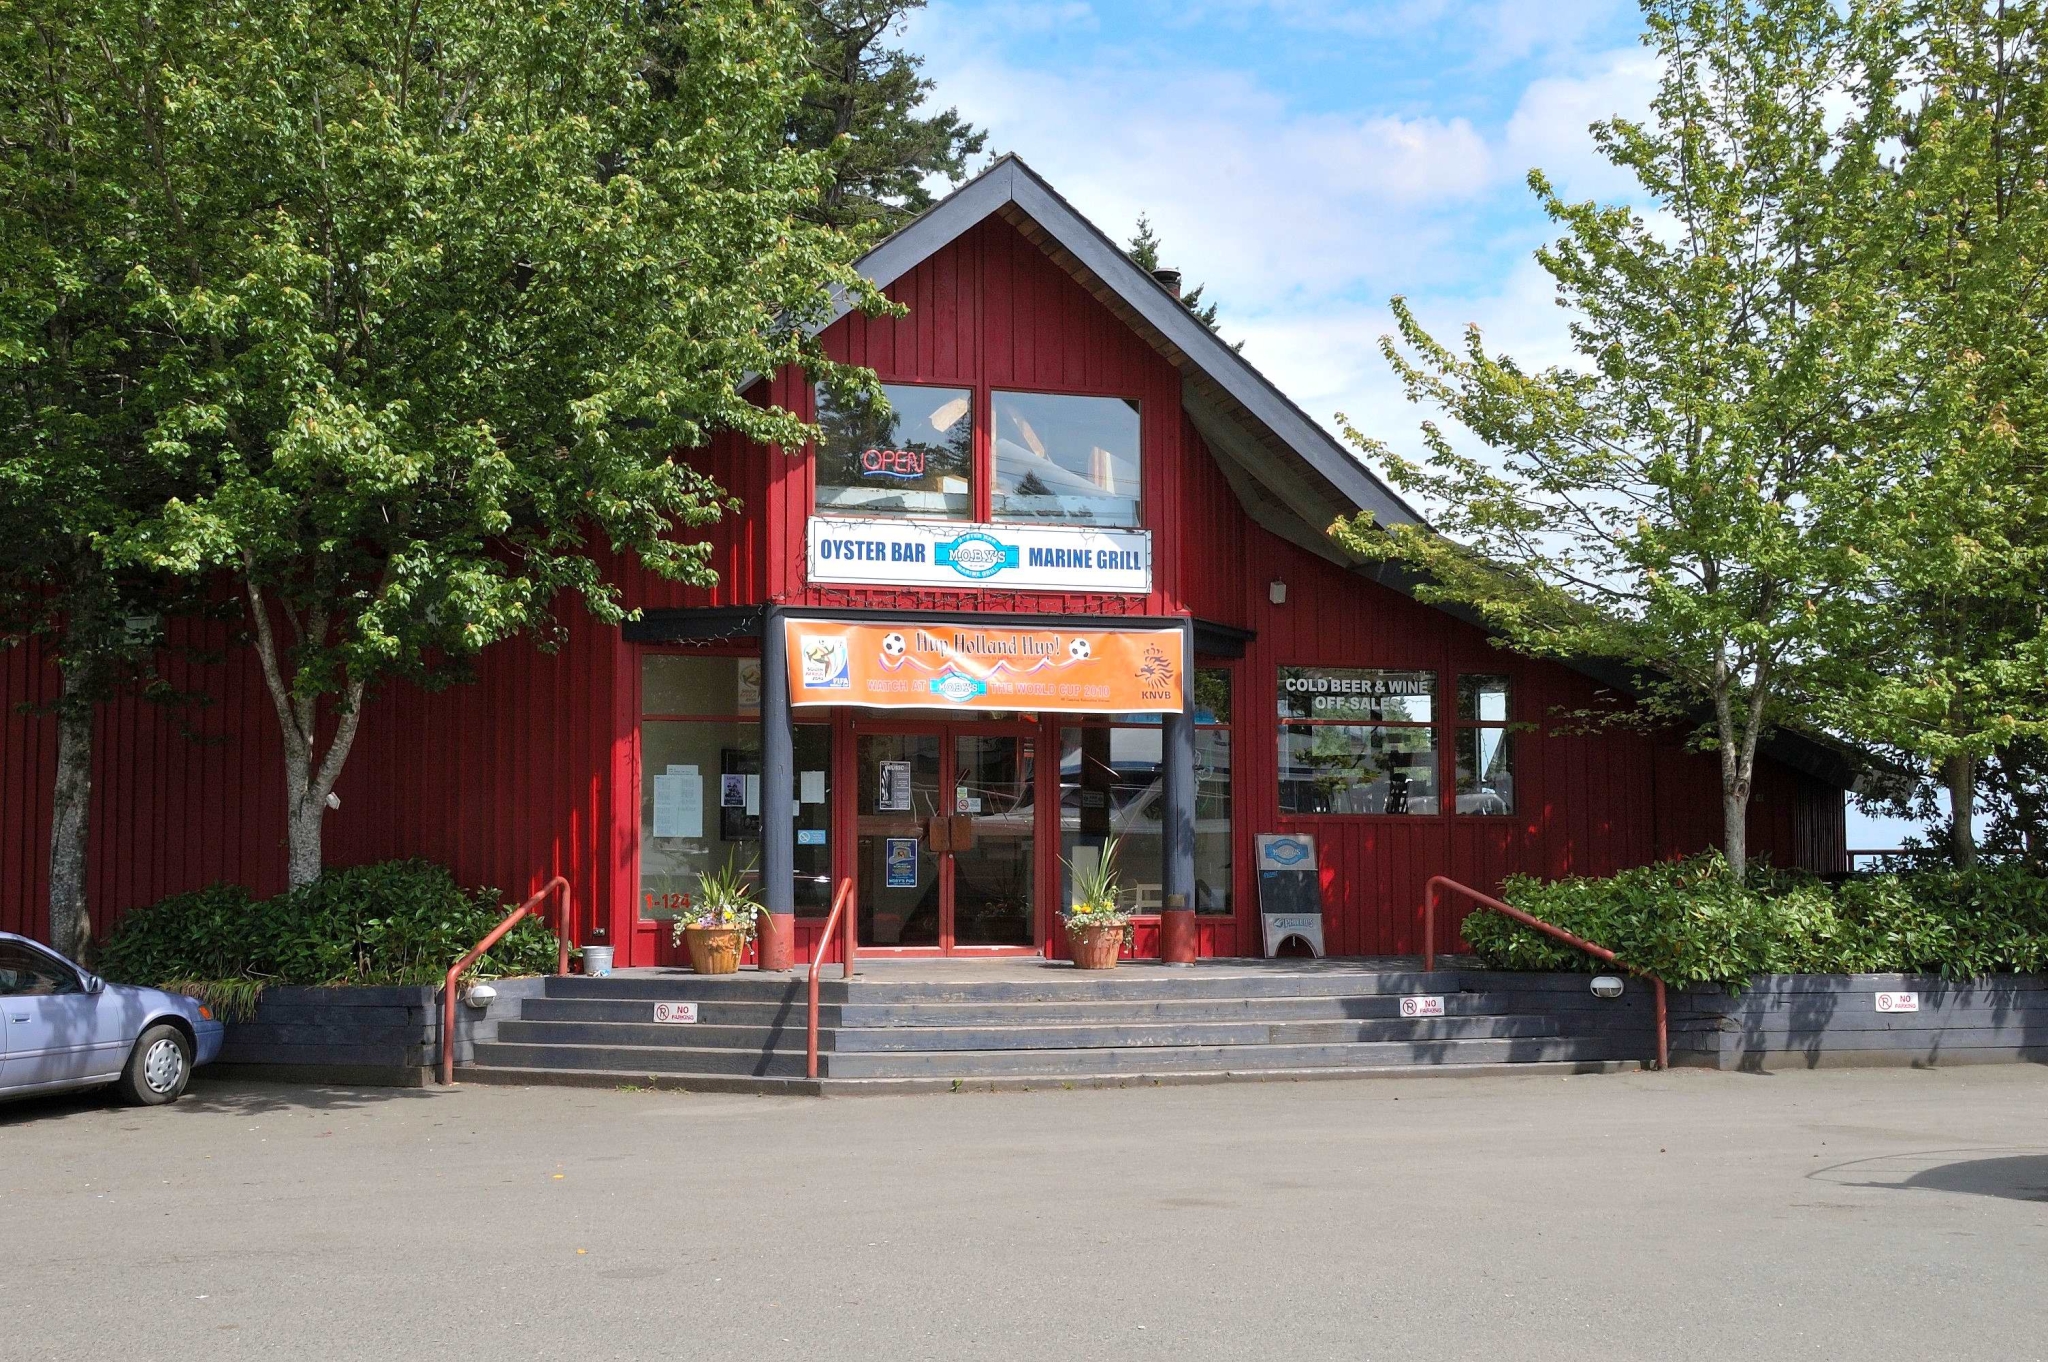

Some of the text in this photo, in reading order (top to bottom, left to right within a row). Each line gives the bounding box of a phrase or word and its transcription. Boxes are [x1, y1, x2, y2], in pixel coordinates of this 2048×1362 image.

[863, 449, 925, 473] OPEN
[820, 539, 926, 563] OYSTER BAR
[1029, 547, 1141, 571] MARINE GRILL
[916, 632, 1060, 660] Hup Holland Hup!
[867, 679, 908, 692] WATCH
[911, 680, 926, 692] AT
[991, 683, 1014, 694] THE
[1016, 684, 1055, 696] WORLD
[1059, 686, 1081, 697] CUP
[1084, 686, 1110, 698] 2010
[1285, 678, 1429, 694] COLD BEER & WINE
[1141, 691, 1171, 700] KNVB
[645, 893, 691, 910] 1-124
[1425, 999, 1436, 1007] NO
[1900, 995, 1911, 1003] NO
[677, 1006, 689, 1014] NO
